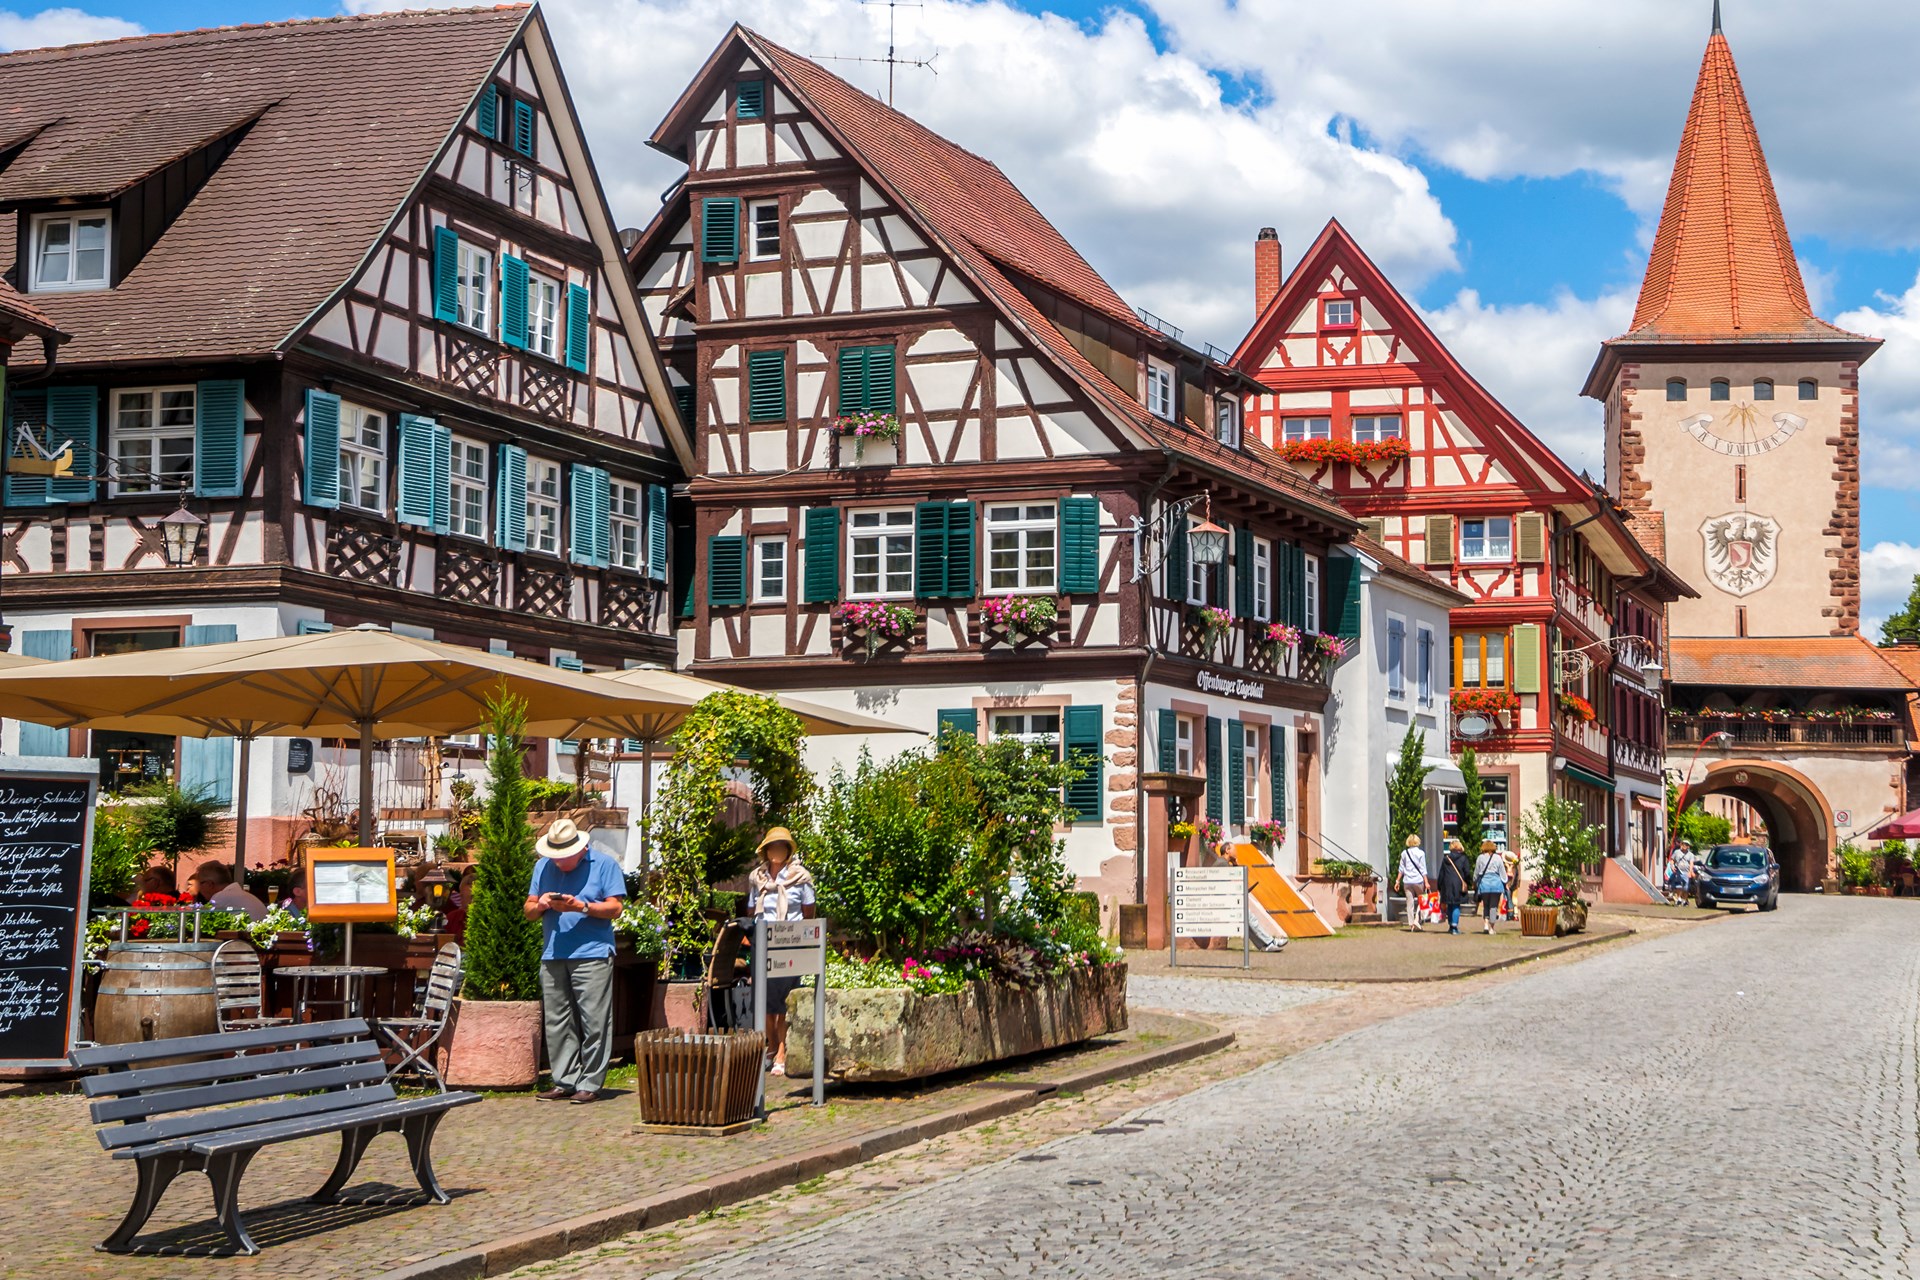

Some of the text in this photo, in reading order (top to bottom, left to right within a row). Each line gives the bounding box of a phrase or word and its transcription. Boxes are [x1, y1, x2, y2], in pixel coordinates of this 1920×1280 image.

[1197, 669, 1264, 699] Offenburger Tageblatt
[59, 812, 80, 823] und
[4, 825, 30, 837] Salat
[50, 847, 70, 858] mit
[12, 874, 32, 883] und
[0, 911, 42, 926] lbsleber
[5, 951, 29, 960] Salat
[45, 993, 63, 1003] mit
[40, 1005, 59, 1016] und
